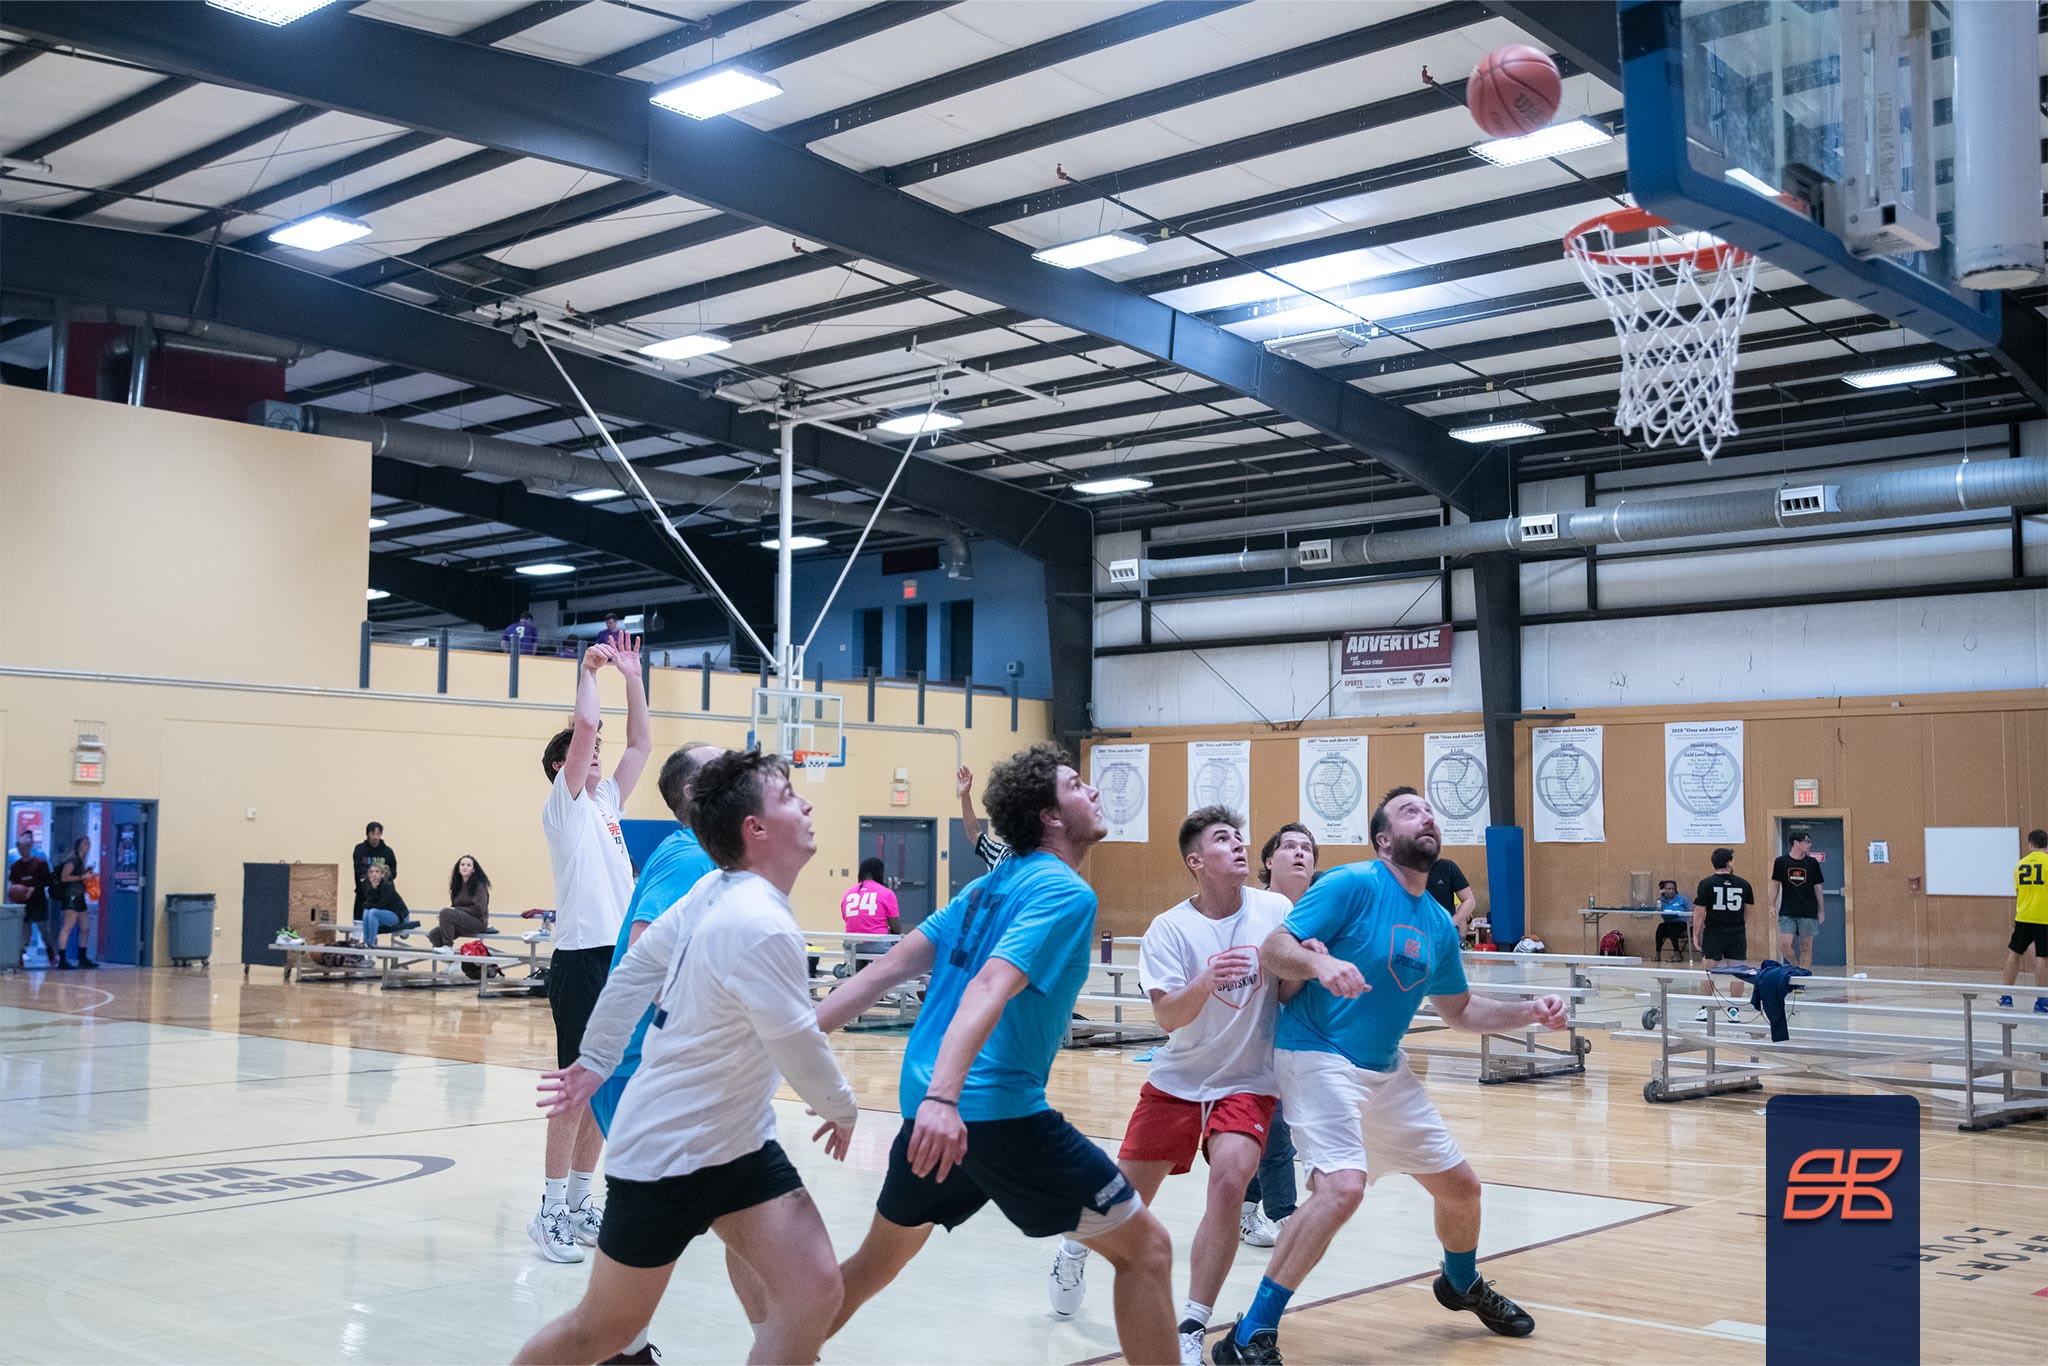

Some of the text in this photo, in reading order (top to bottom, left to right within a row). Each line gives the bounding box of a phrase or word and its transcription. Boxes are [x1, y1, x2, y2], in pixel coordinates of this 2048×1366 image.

[1346, 630, 1441, 654] ADVERTISE
[1344, 679, 1363, 687] SPORTS
[1798, 791, 1814, 803] EXIT
[2018, 864, 2045, 885] 21
[845, 892, 878, 917] 24
[1712, 886, 1743, 911] 15
[0, 1169, 380, 1224] AUSTIN JU
